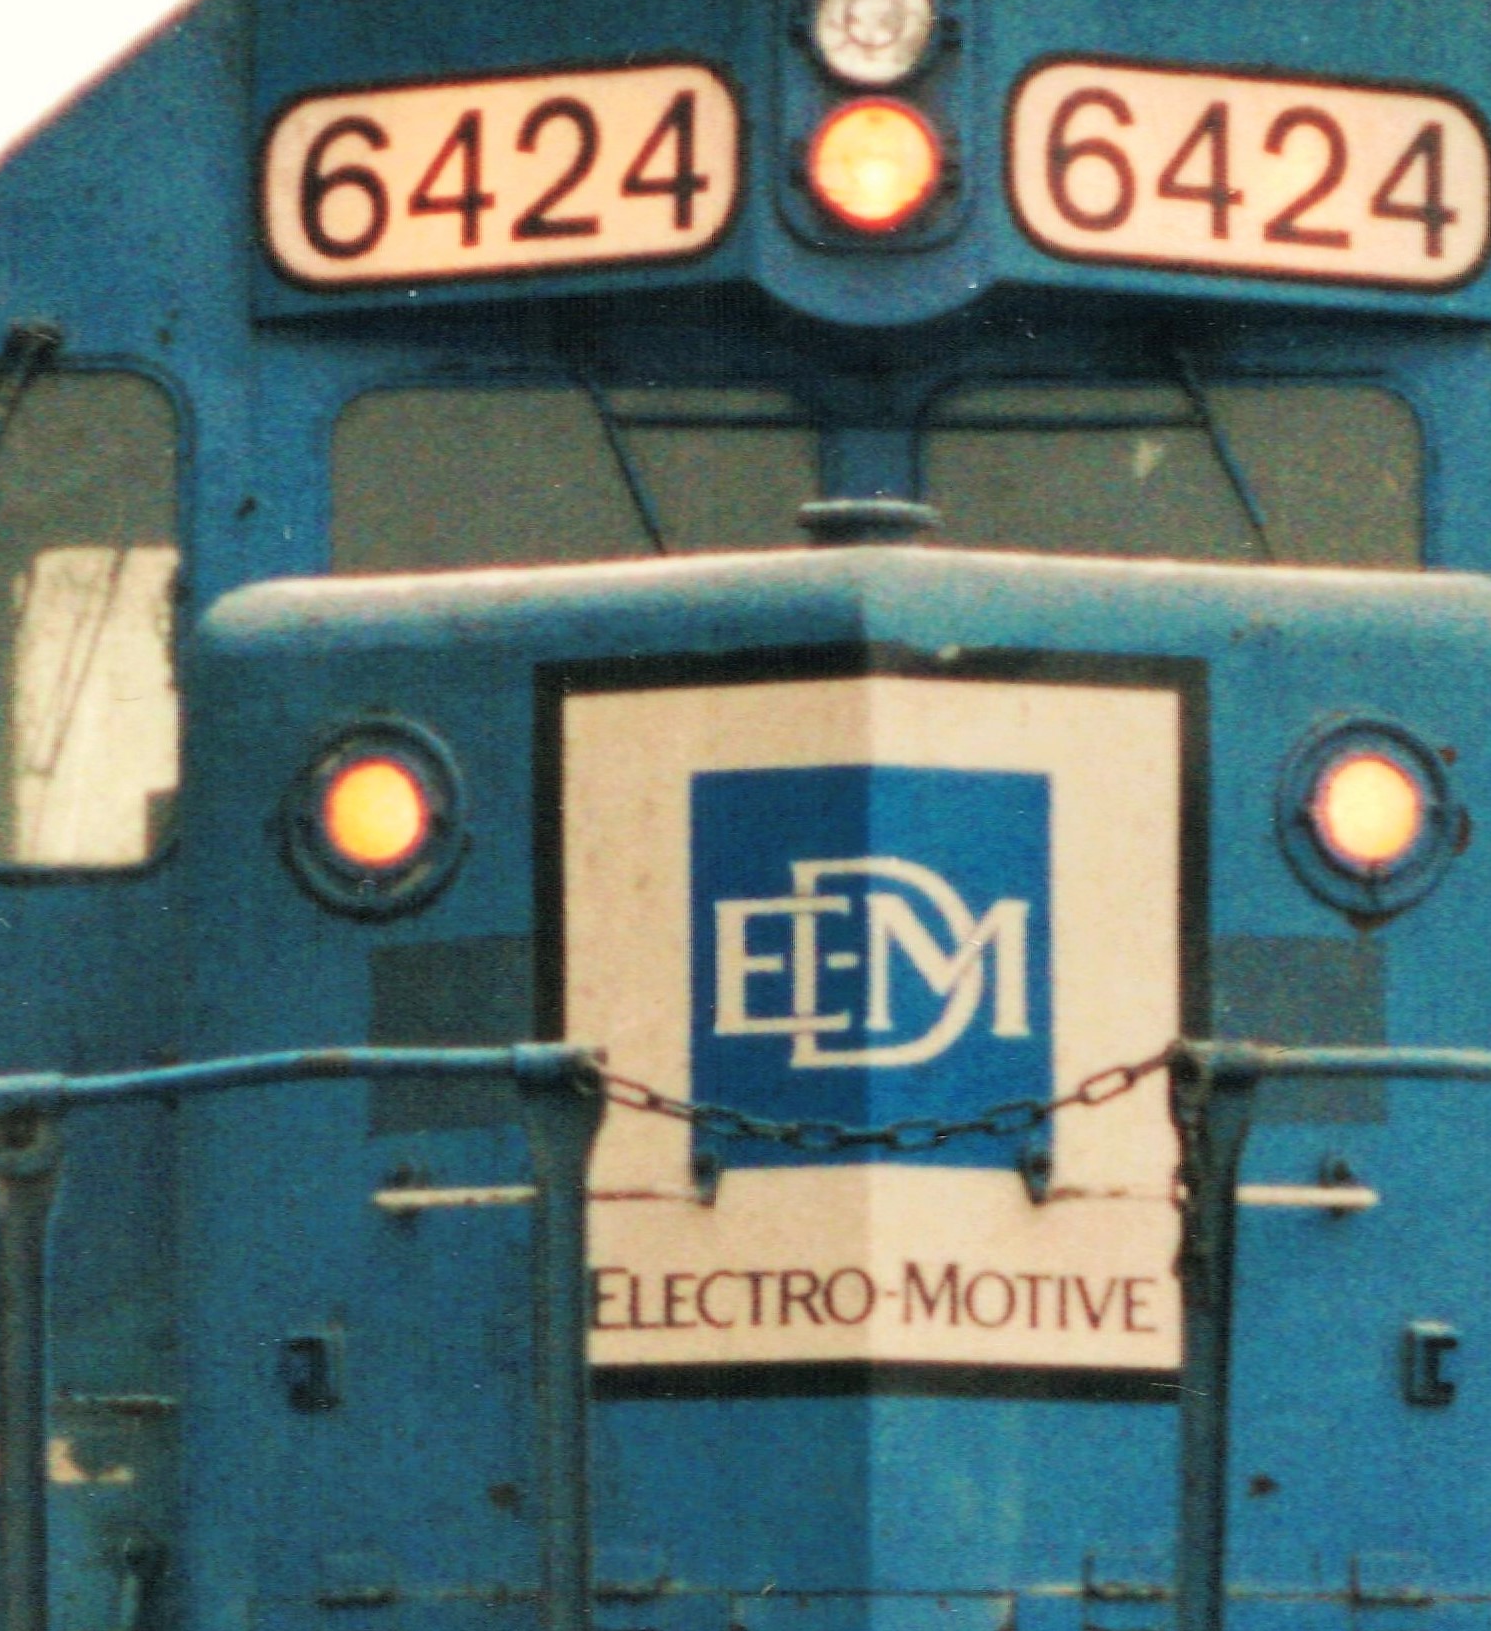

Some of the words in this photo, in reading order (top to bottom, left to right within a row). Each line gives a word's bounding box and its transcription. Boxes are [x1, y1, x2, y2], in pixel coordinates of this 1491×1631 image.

[301, 87, 708, 261] 6424
[1046, 87, 1459, 260] 6424
[591, 1263, 1157, 1332] ELECTRO-MOTIVE
